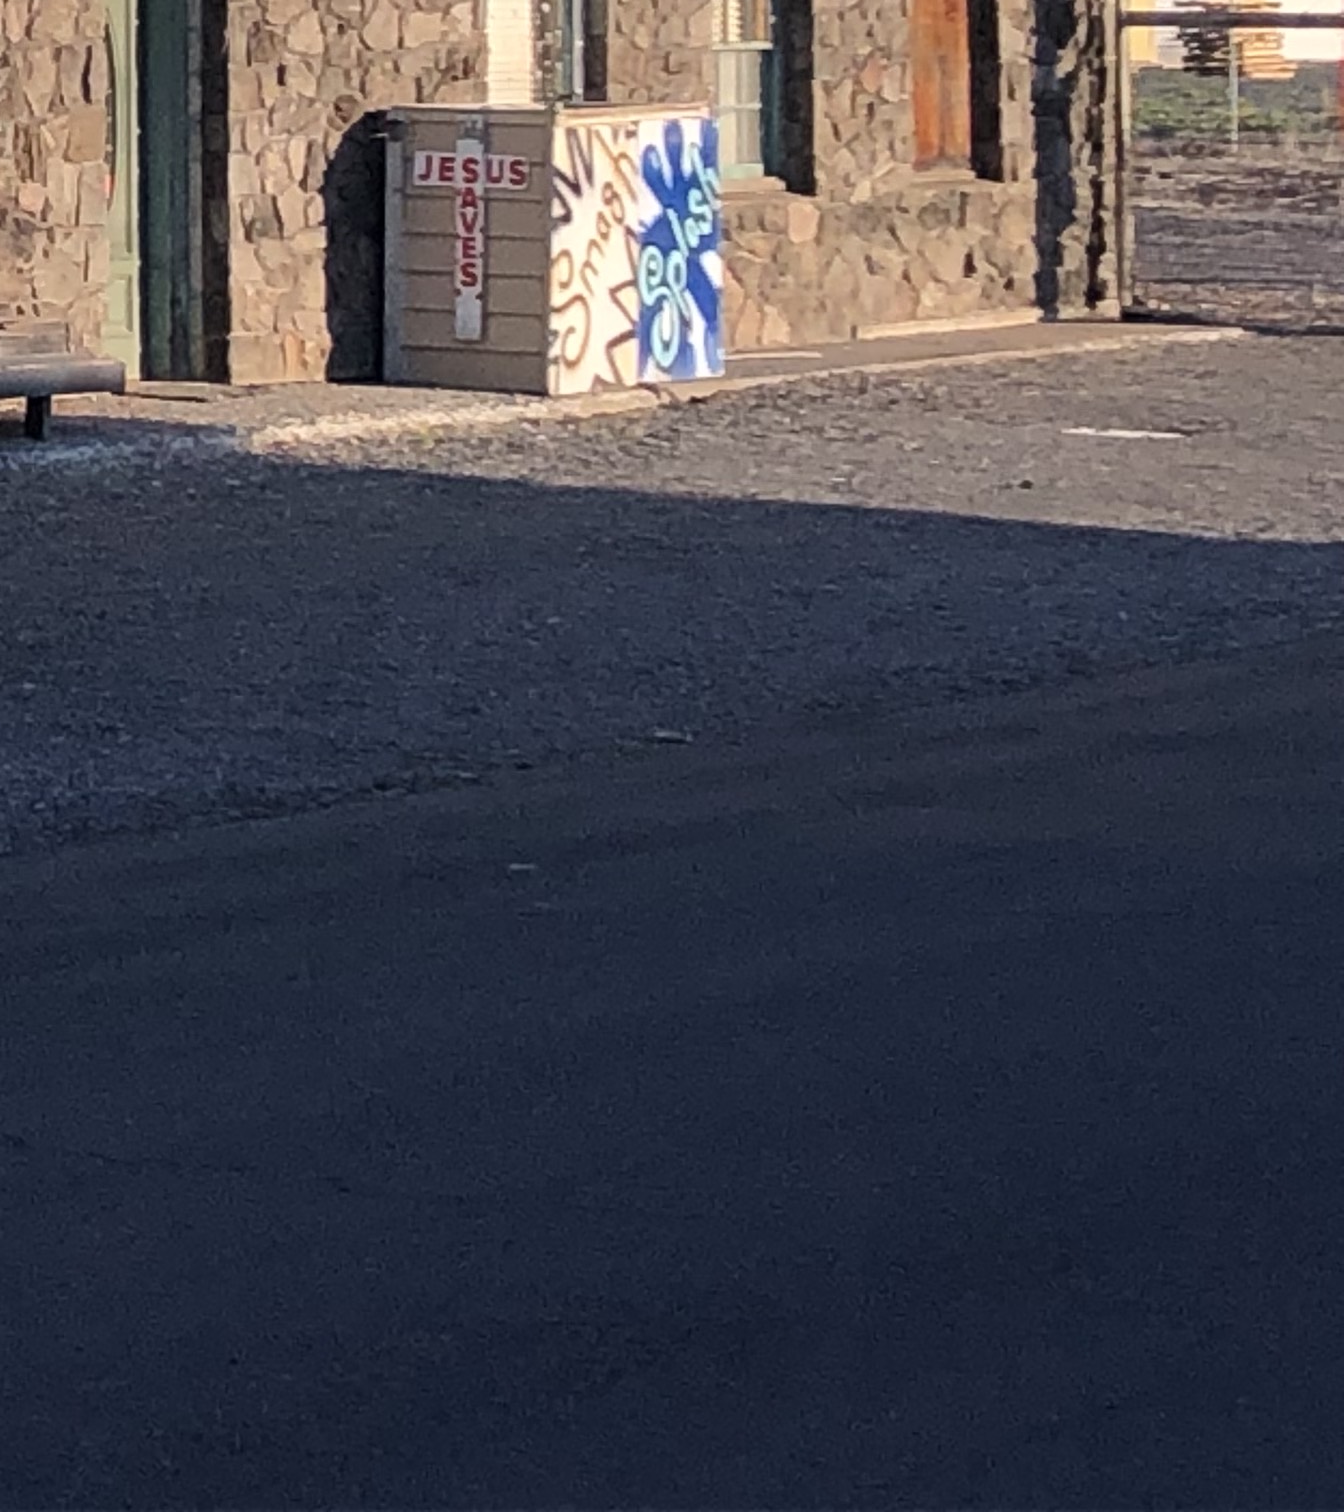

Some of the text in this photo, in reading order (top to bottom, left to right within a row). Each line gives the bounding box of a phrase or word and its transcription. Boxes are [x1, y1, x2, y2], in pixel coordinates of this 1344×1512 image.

[417, 155, 527, 186] JESUS
[458, 156, 480, 287] SAVES
[551, 128, 638, 368] Smash
[639, 142, 721, 372] Splash
